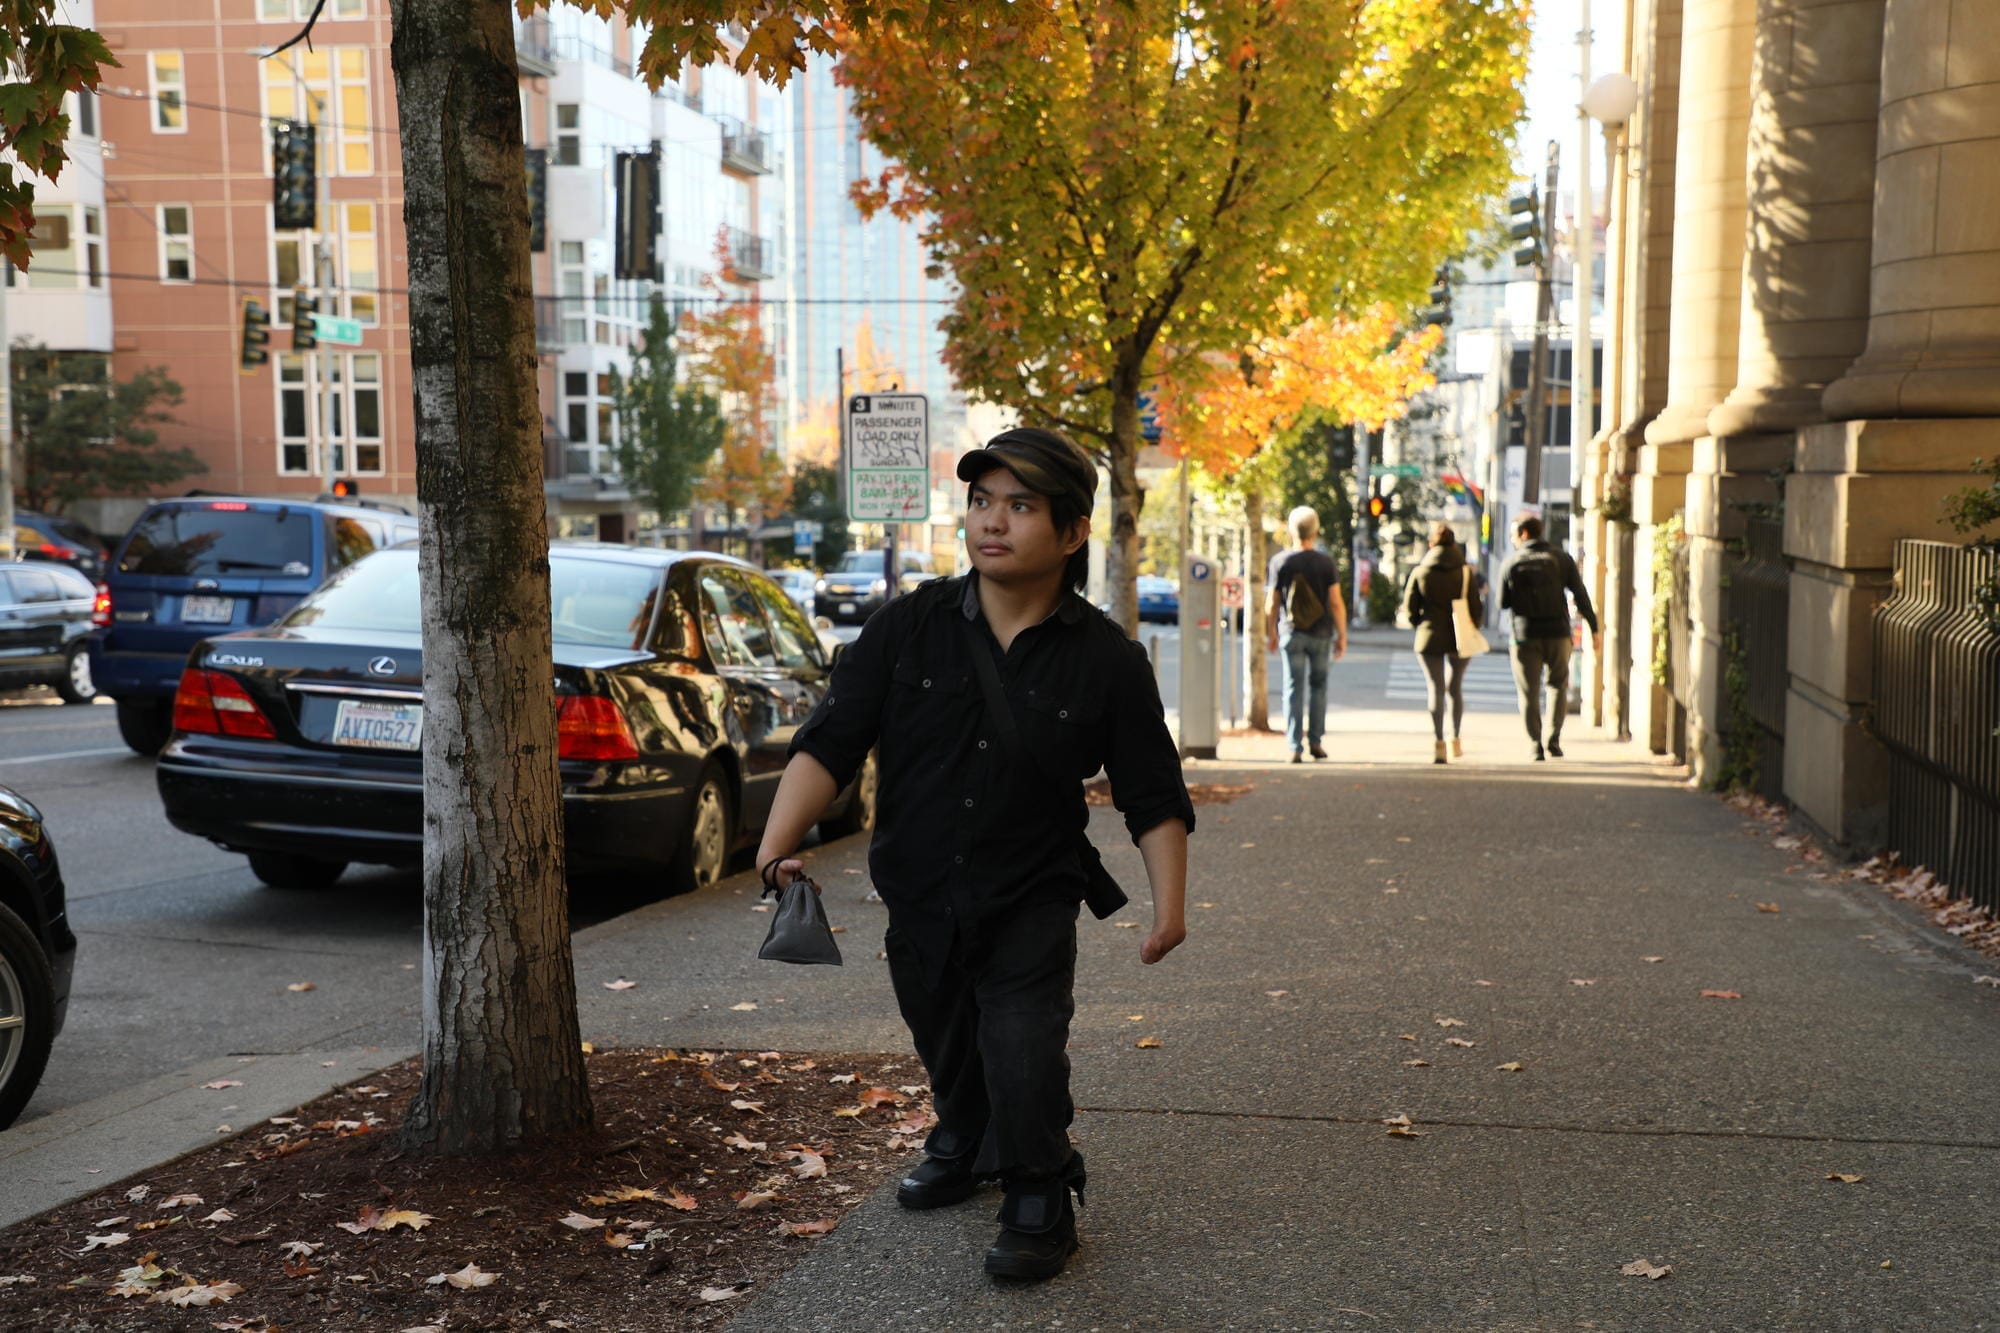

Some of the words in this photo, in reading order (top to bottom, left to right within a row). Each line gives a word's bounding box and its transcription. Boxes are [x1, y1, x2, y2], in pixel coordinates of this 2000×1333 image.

[855, 398, 866, 411] 3
[878, 401, 916, 411] MINUTE
[855, 417, 922, 428] PASSENGER
[857, 431, 887, 441] LOAD
[890, 431, 920, 441] ONLY
[894, 474, 922, 484] PARK
[211, 654, 264, 667] LEXUS
